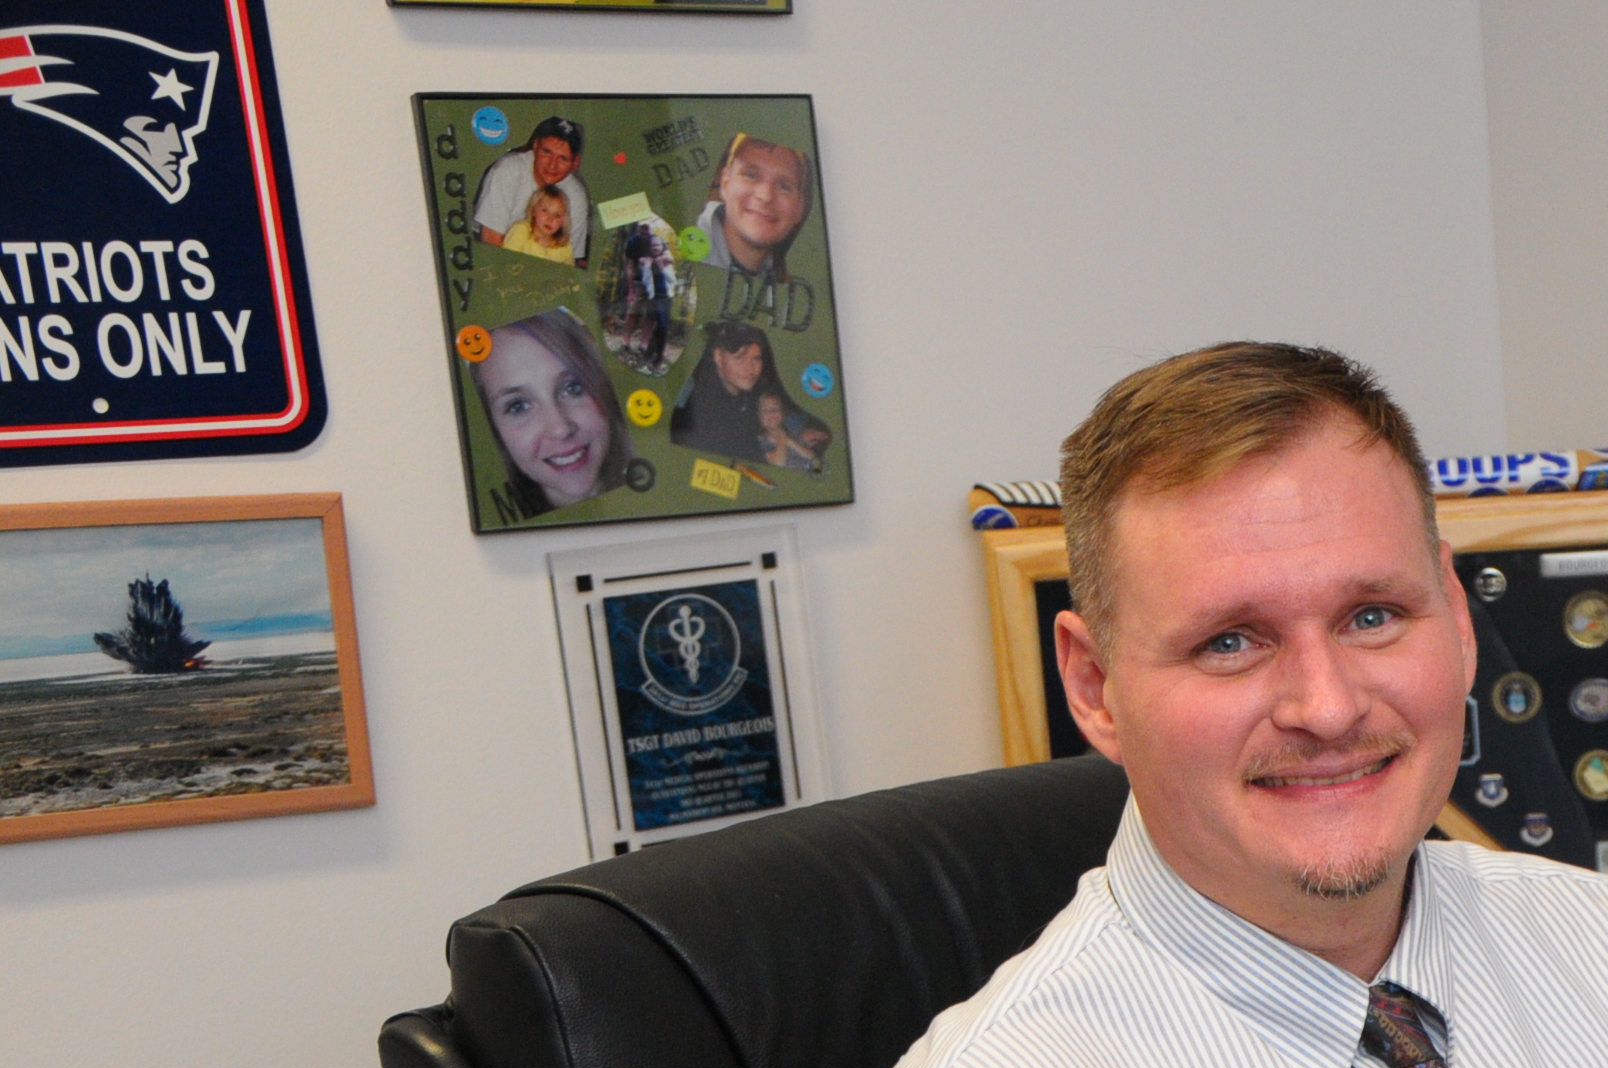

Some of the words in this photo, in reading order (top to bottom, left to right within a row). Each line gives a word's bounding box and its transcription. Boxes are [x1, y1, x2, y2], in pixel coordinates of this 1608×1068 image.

[652, 147, 710, 188] DAD
[0, 240, 216, 304] TRIOTS
[720, 266, 815, 332] DAD
[0, 314, 81, 382] NS
[97, 309, 252, 379] ONLY
[1429, 452, 1570, 487] OOPS
[662, 728, 700, 749] DAVID
[704, 718, 775, 742] BOURGEOIS
